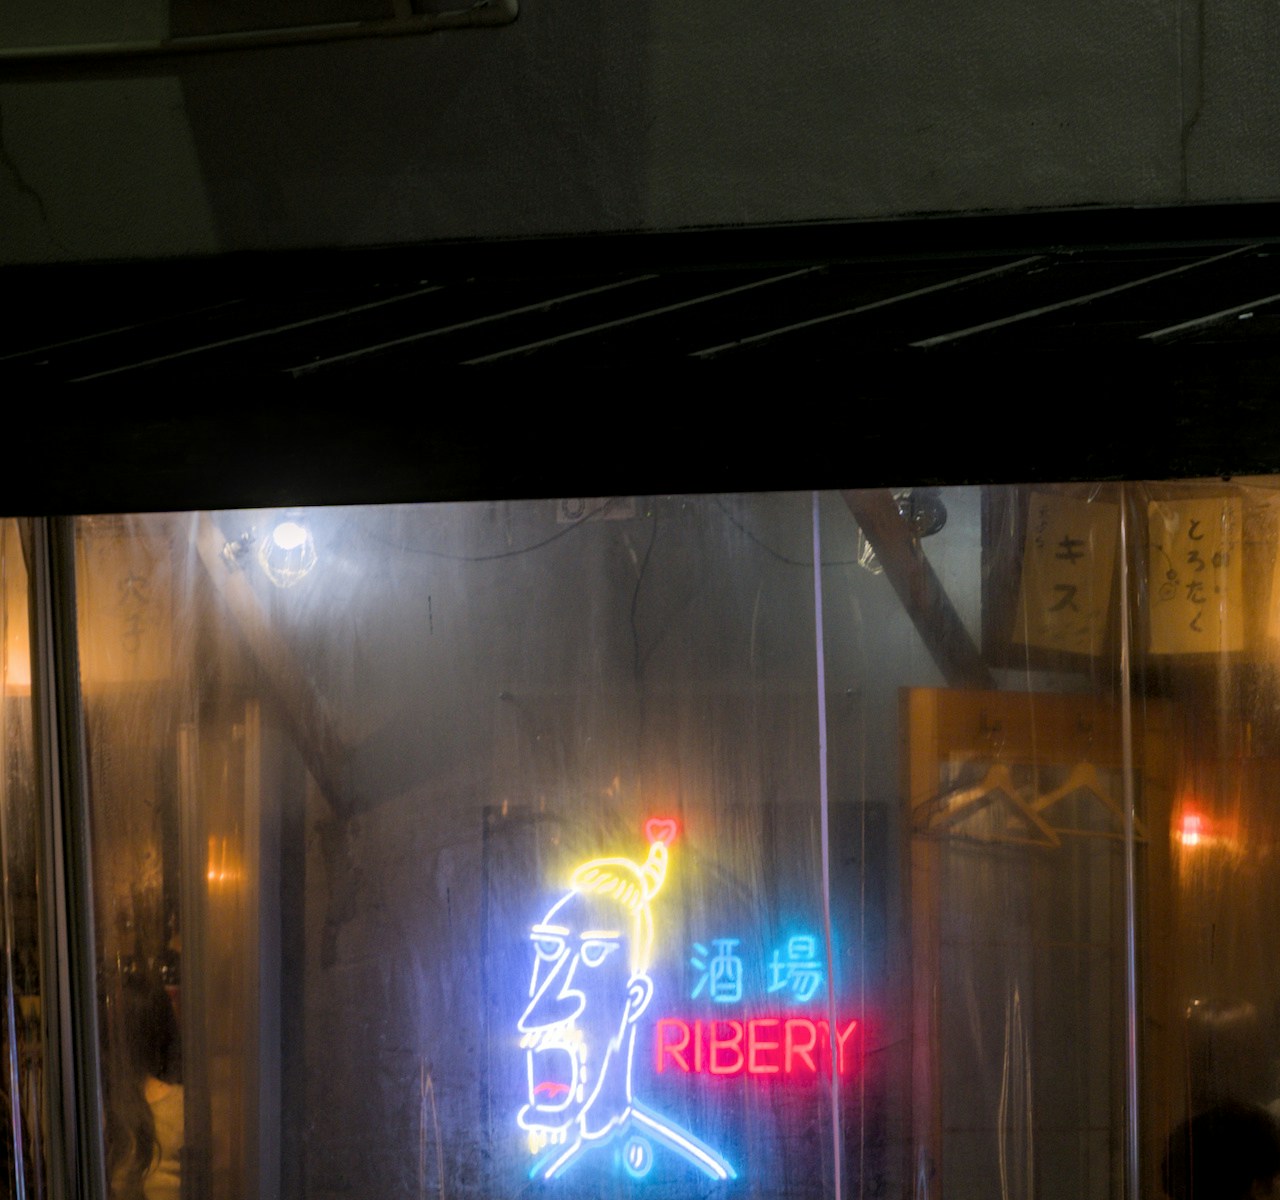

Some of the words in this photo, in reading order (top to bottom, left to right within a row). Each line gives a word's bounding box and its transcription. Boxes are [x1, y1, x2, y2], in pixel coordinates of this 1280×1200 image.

[1048, 533, 1085, 613] キス
[690, 935, 826, 1003] 酒場
[655, 1017, 858, 1074] RIBERY
